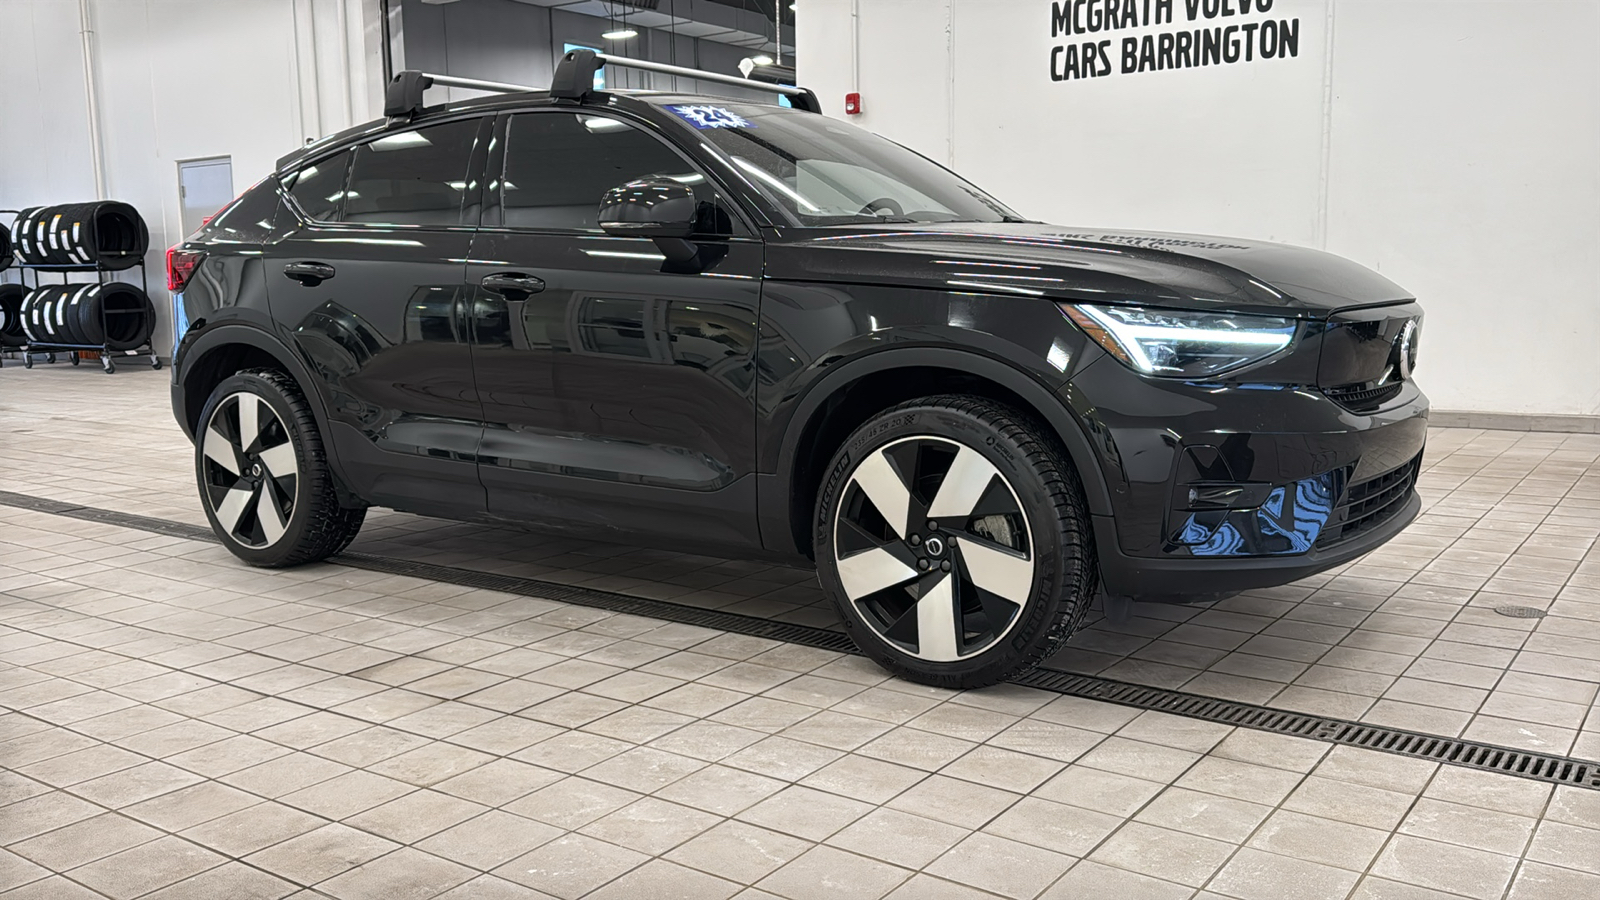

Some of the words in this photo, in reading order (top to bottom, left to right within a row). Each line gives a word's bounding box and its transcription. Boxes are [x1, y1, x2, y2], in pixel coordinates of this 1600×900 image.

[1051, 0, 1173, 37] MCGRATH
[1050, 40, 1111, 81] CARS
[1121, 18, 1299, 74] BARRINGTON
[692, 109, 734, 122] 24
[891, 418, 901, 427] 20
[819, 454, 849, 523] MICHELIN
